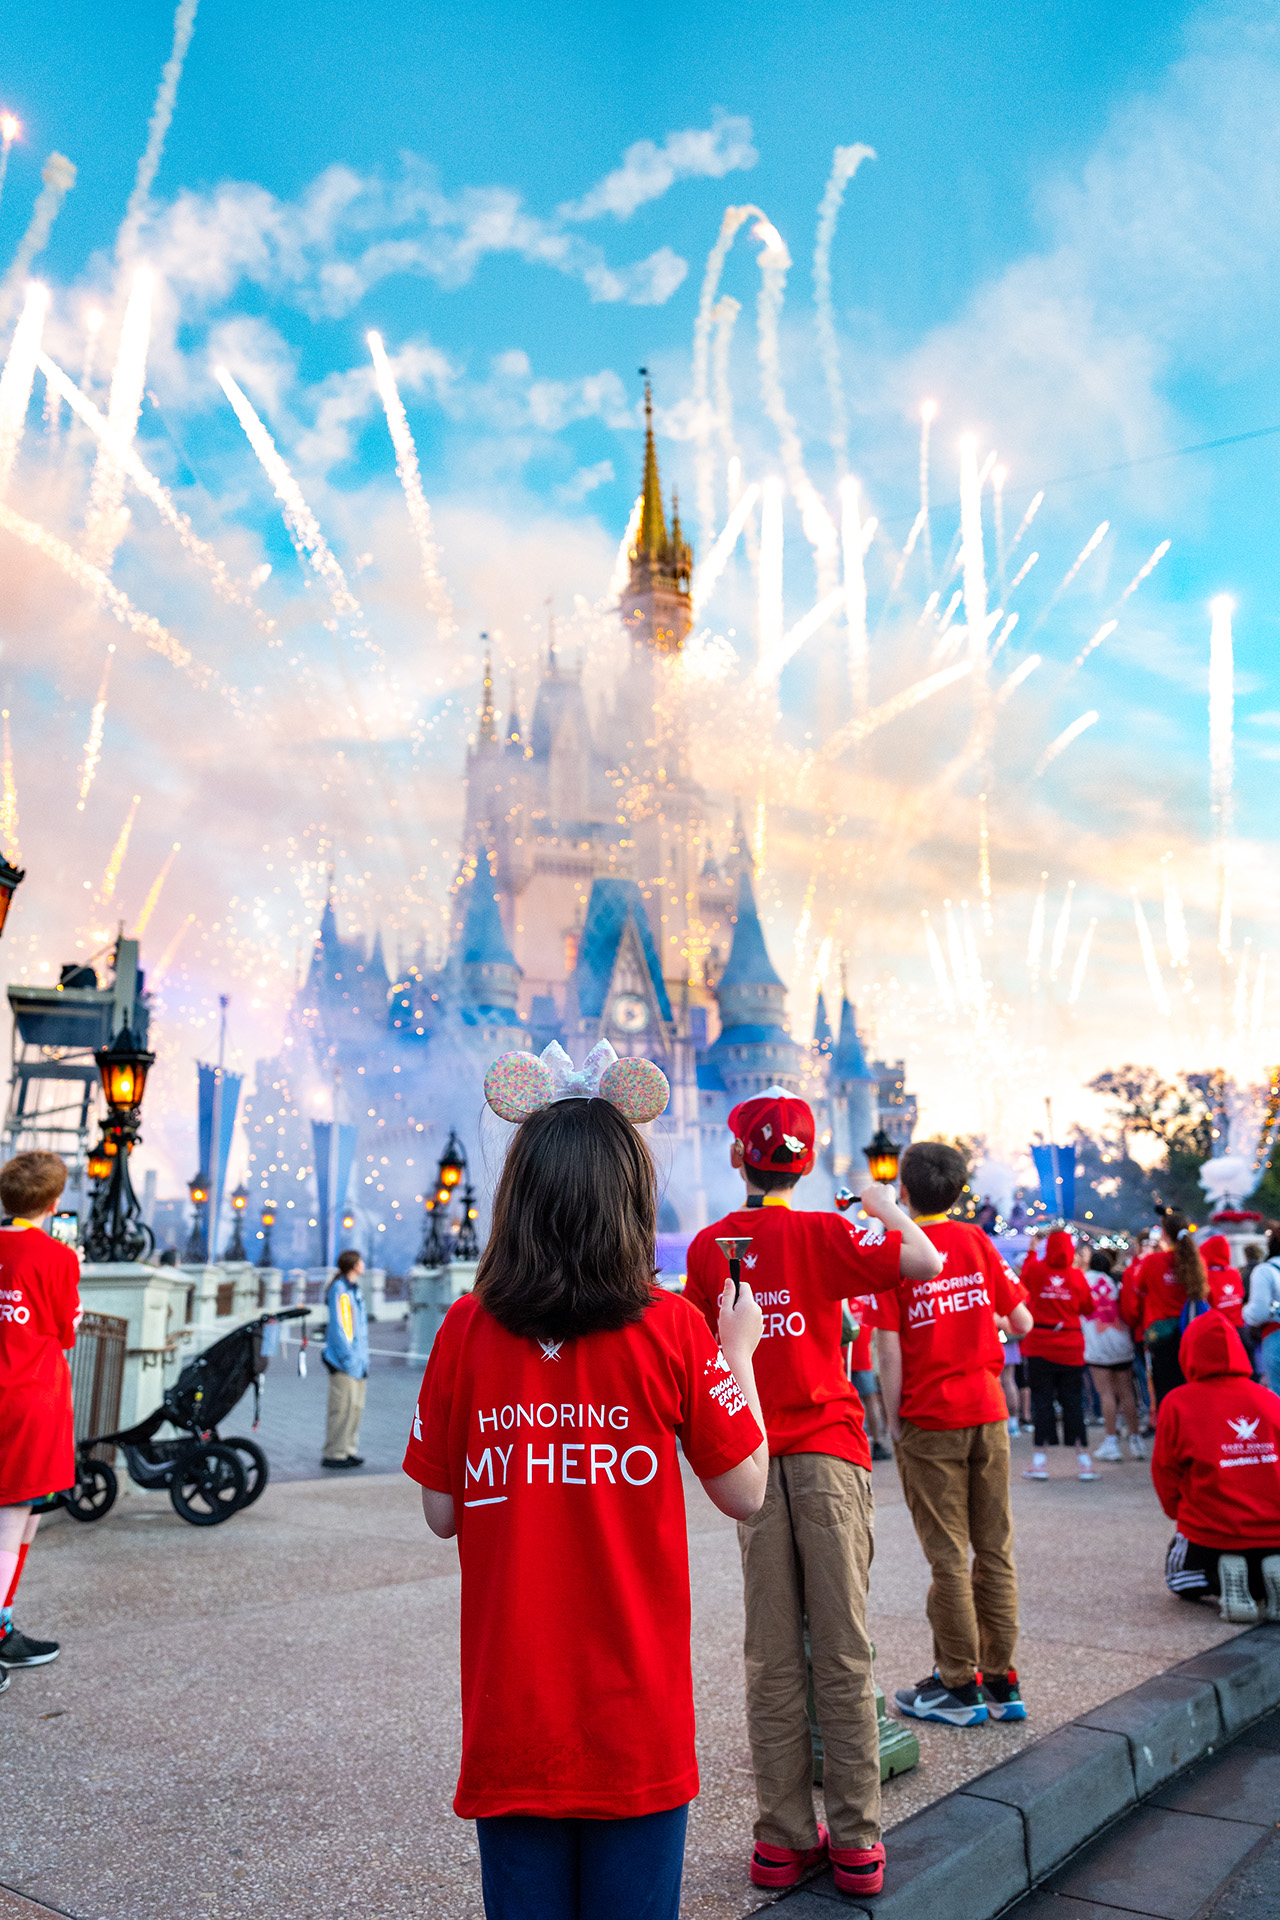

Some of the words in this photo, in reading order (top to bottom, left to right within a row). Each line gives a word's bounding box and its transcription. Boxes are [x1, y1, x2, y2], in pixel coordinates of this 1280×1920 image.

[912, 1271, 984, 1298] HONORING
[908, 1298, 936, 1322] MY
[761, 1311, 806, 1338] ERO
[478, 1402, 629, 1433] HONORING
[465, 1444, 514, 1489] MY
[527, 1443, 658, 1486] HERO
